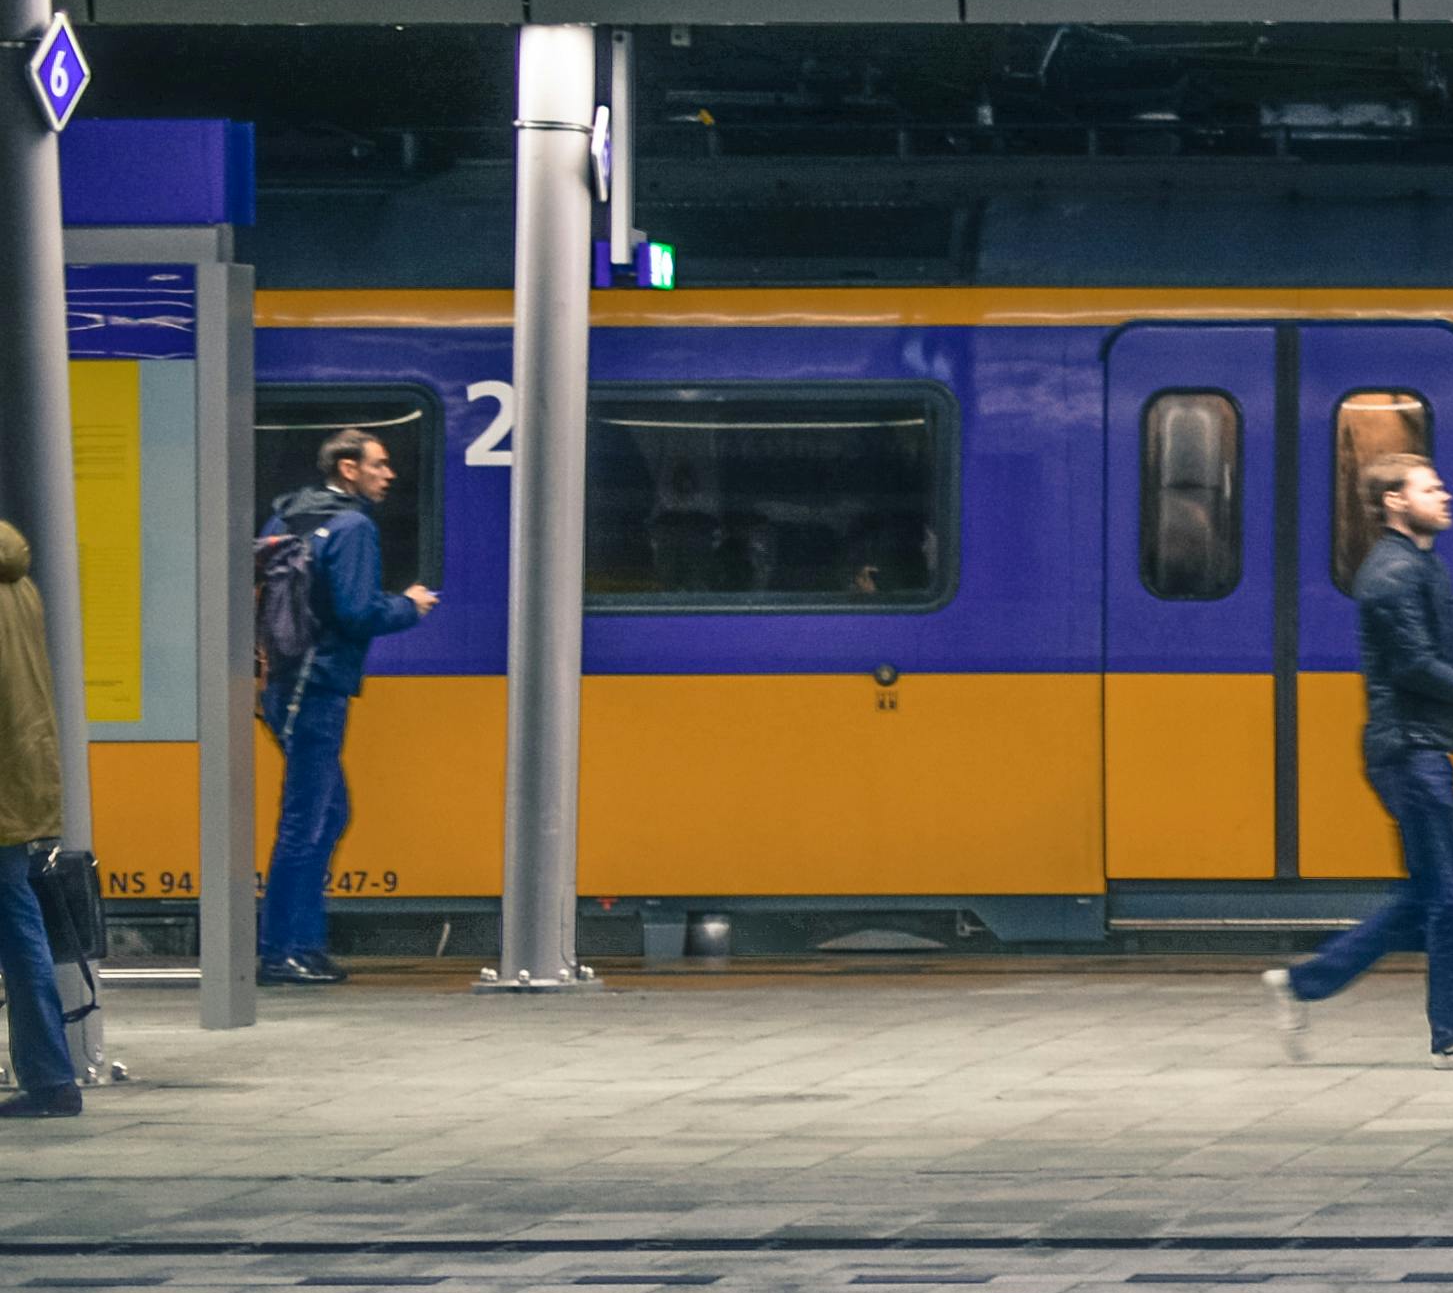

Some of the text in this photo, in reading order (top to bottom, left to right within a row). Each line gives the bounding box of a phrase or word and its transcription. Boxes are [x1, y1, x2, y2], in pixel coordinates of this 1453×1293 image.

[50, 50, 69, 98] 6
[465, 380, 514, 466] 2
[109, 871, 146, 893] NS
[160, 871, 193, 893] 94
